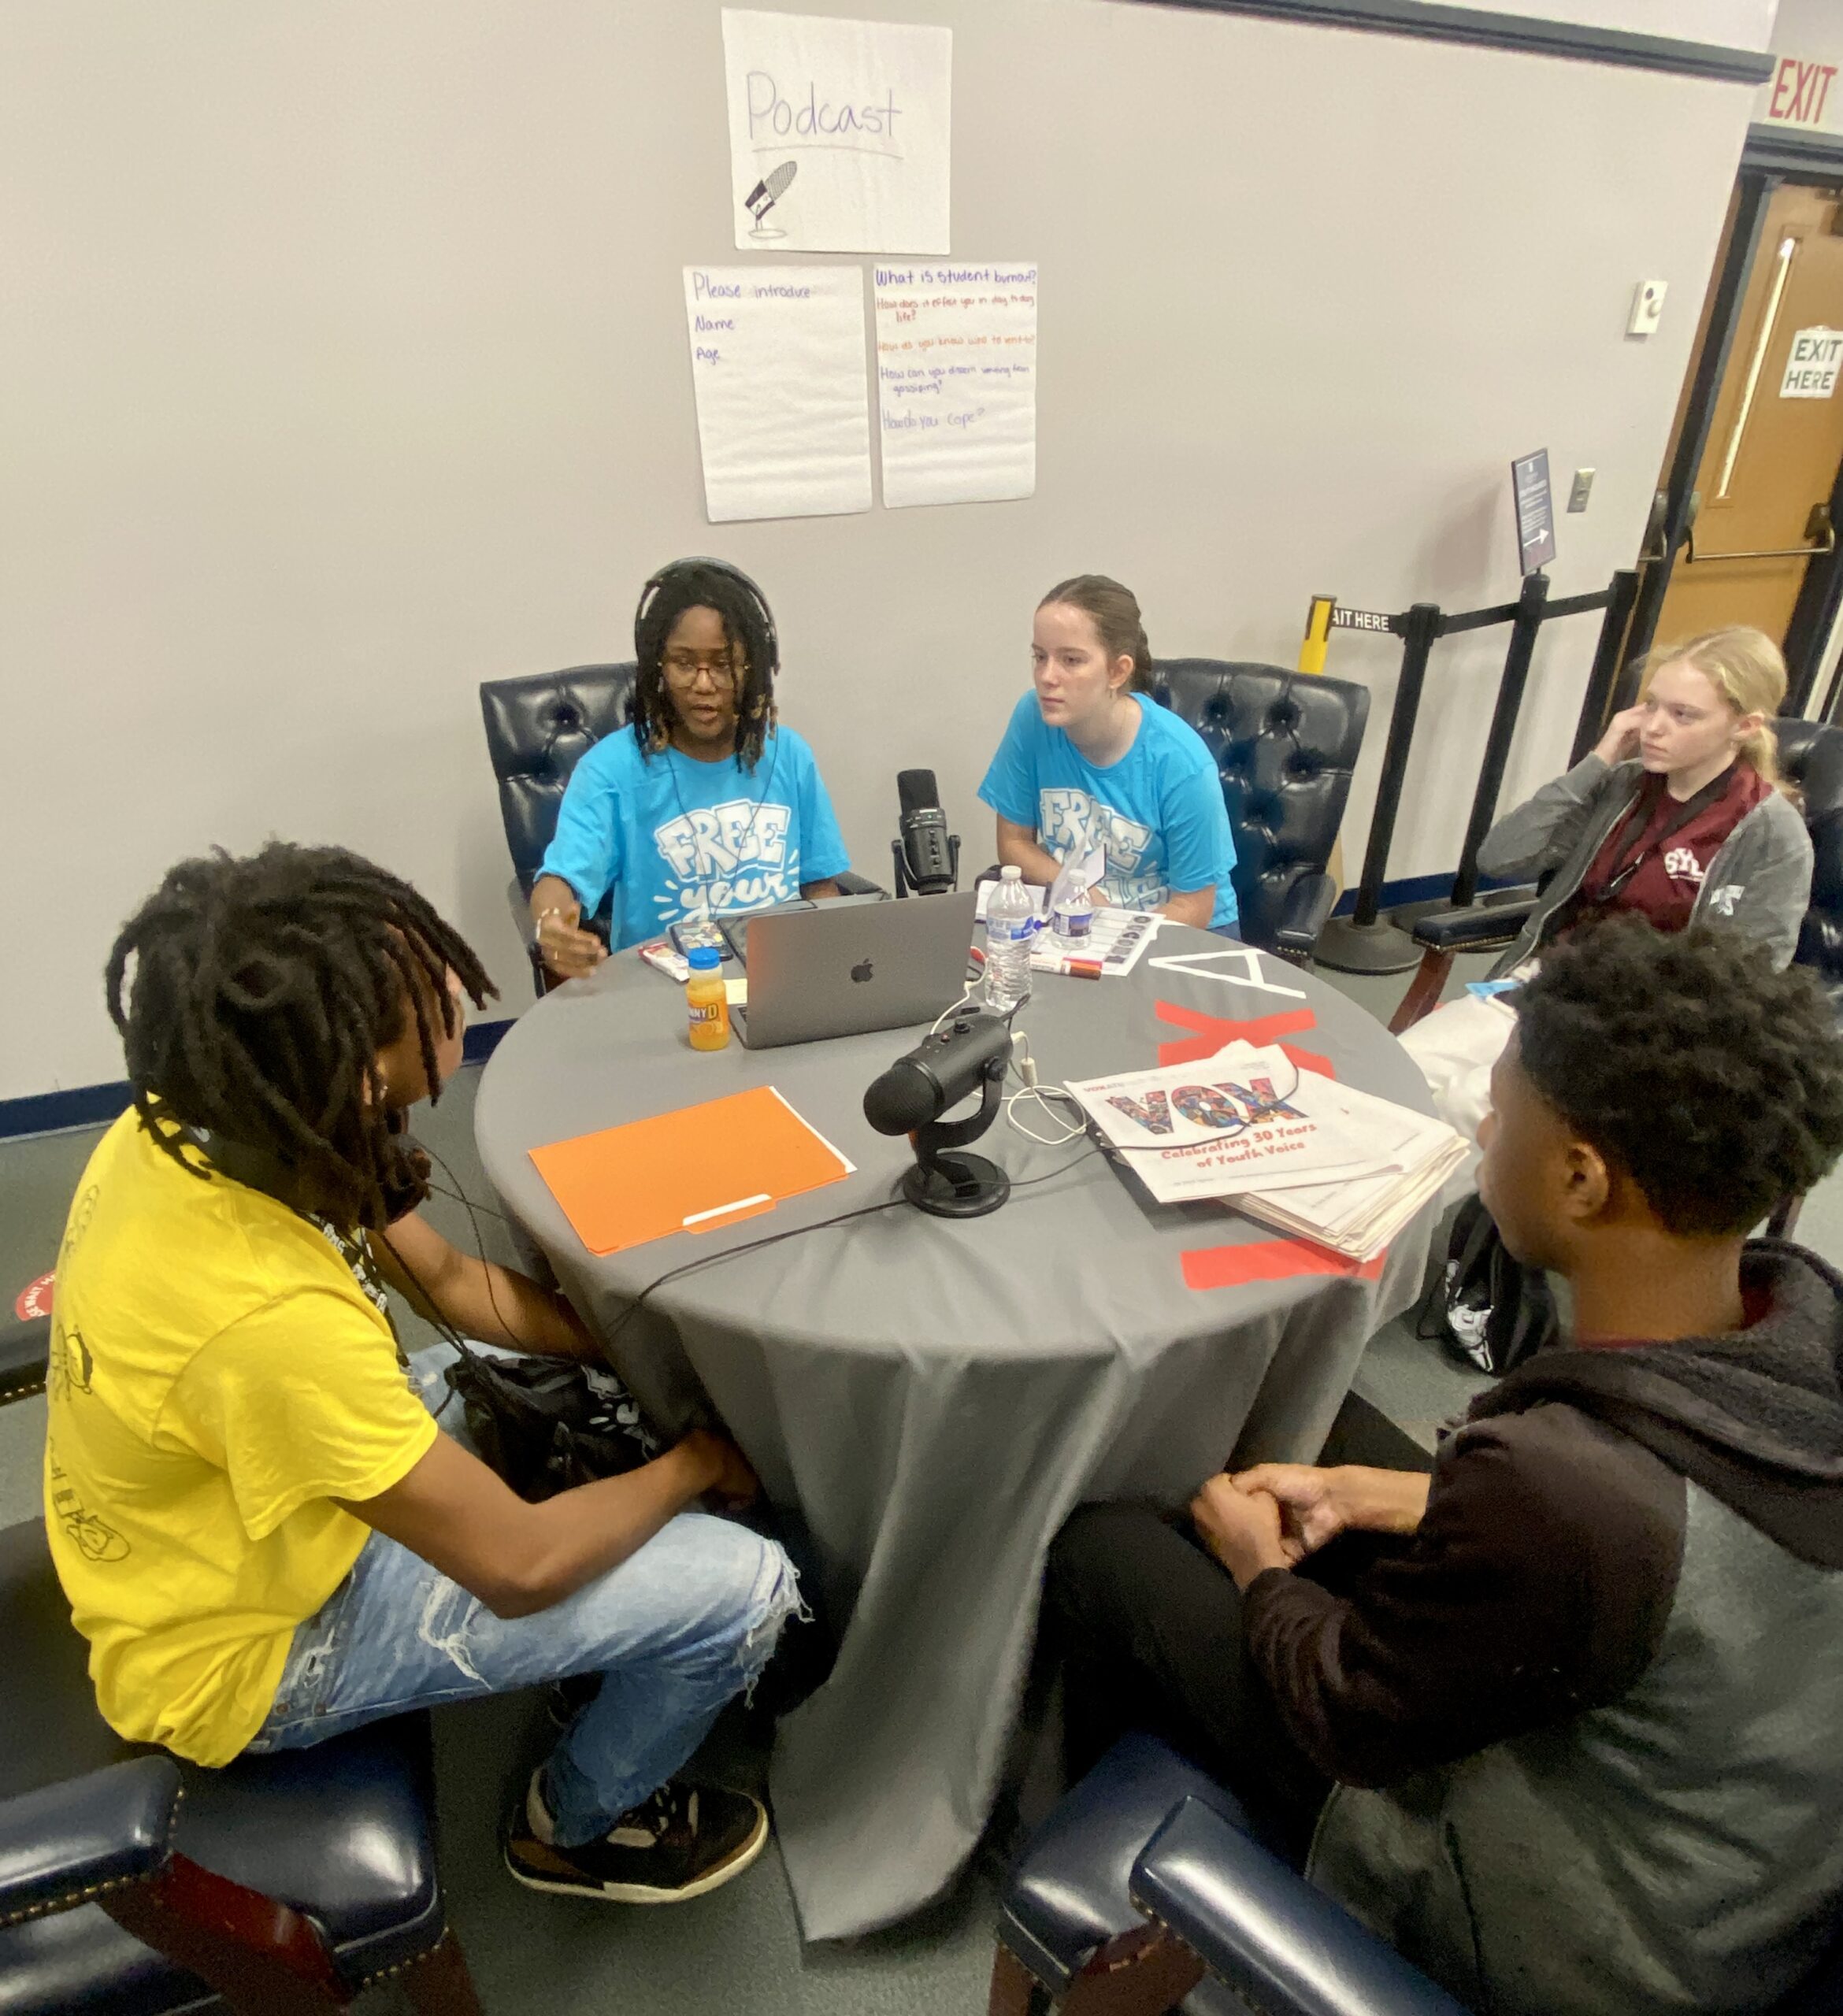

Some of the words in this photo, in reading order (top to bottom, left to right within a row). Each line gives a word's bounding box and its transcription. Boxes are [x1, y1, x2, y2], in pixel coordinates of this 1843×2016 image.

[1769, 58, 1838, 124] EXIT
[746, 70, 903, 139] Podcast
[692, 271, 741, 302] Please
[876, 269, 914, 286] What
[921, 269, 933, 284] is
[937, 269, 990, 284] student
[695, 315, 735, 332] Name
[696, 346, 721, 366] Age
[1794, 338, 1843, 361] EXIT
[881, 365, 905, 380] How
[907, 369, 925, 379] can
[1785, 370, 1834, 390] HERE
[919, 415, 939, 430] you
[1332, 609, 1352, 625] AIT
[1355, 612, 1389, 631] HERE
[653, 798, 792, 884] FREE
[1104, 1077, 1310, 1136] VOX
[1161, 1136, 1251, 1160] Celebrating
[1252, 1129, 1274, 1143] 30
[1275, 1123, 1318, 1138] Years
[1196, 1157, 1213, 1169] of
[1215, 1148, 1264, 1166] Youth
[1264, 1140, 1307, 1155] Voice
